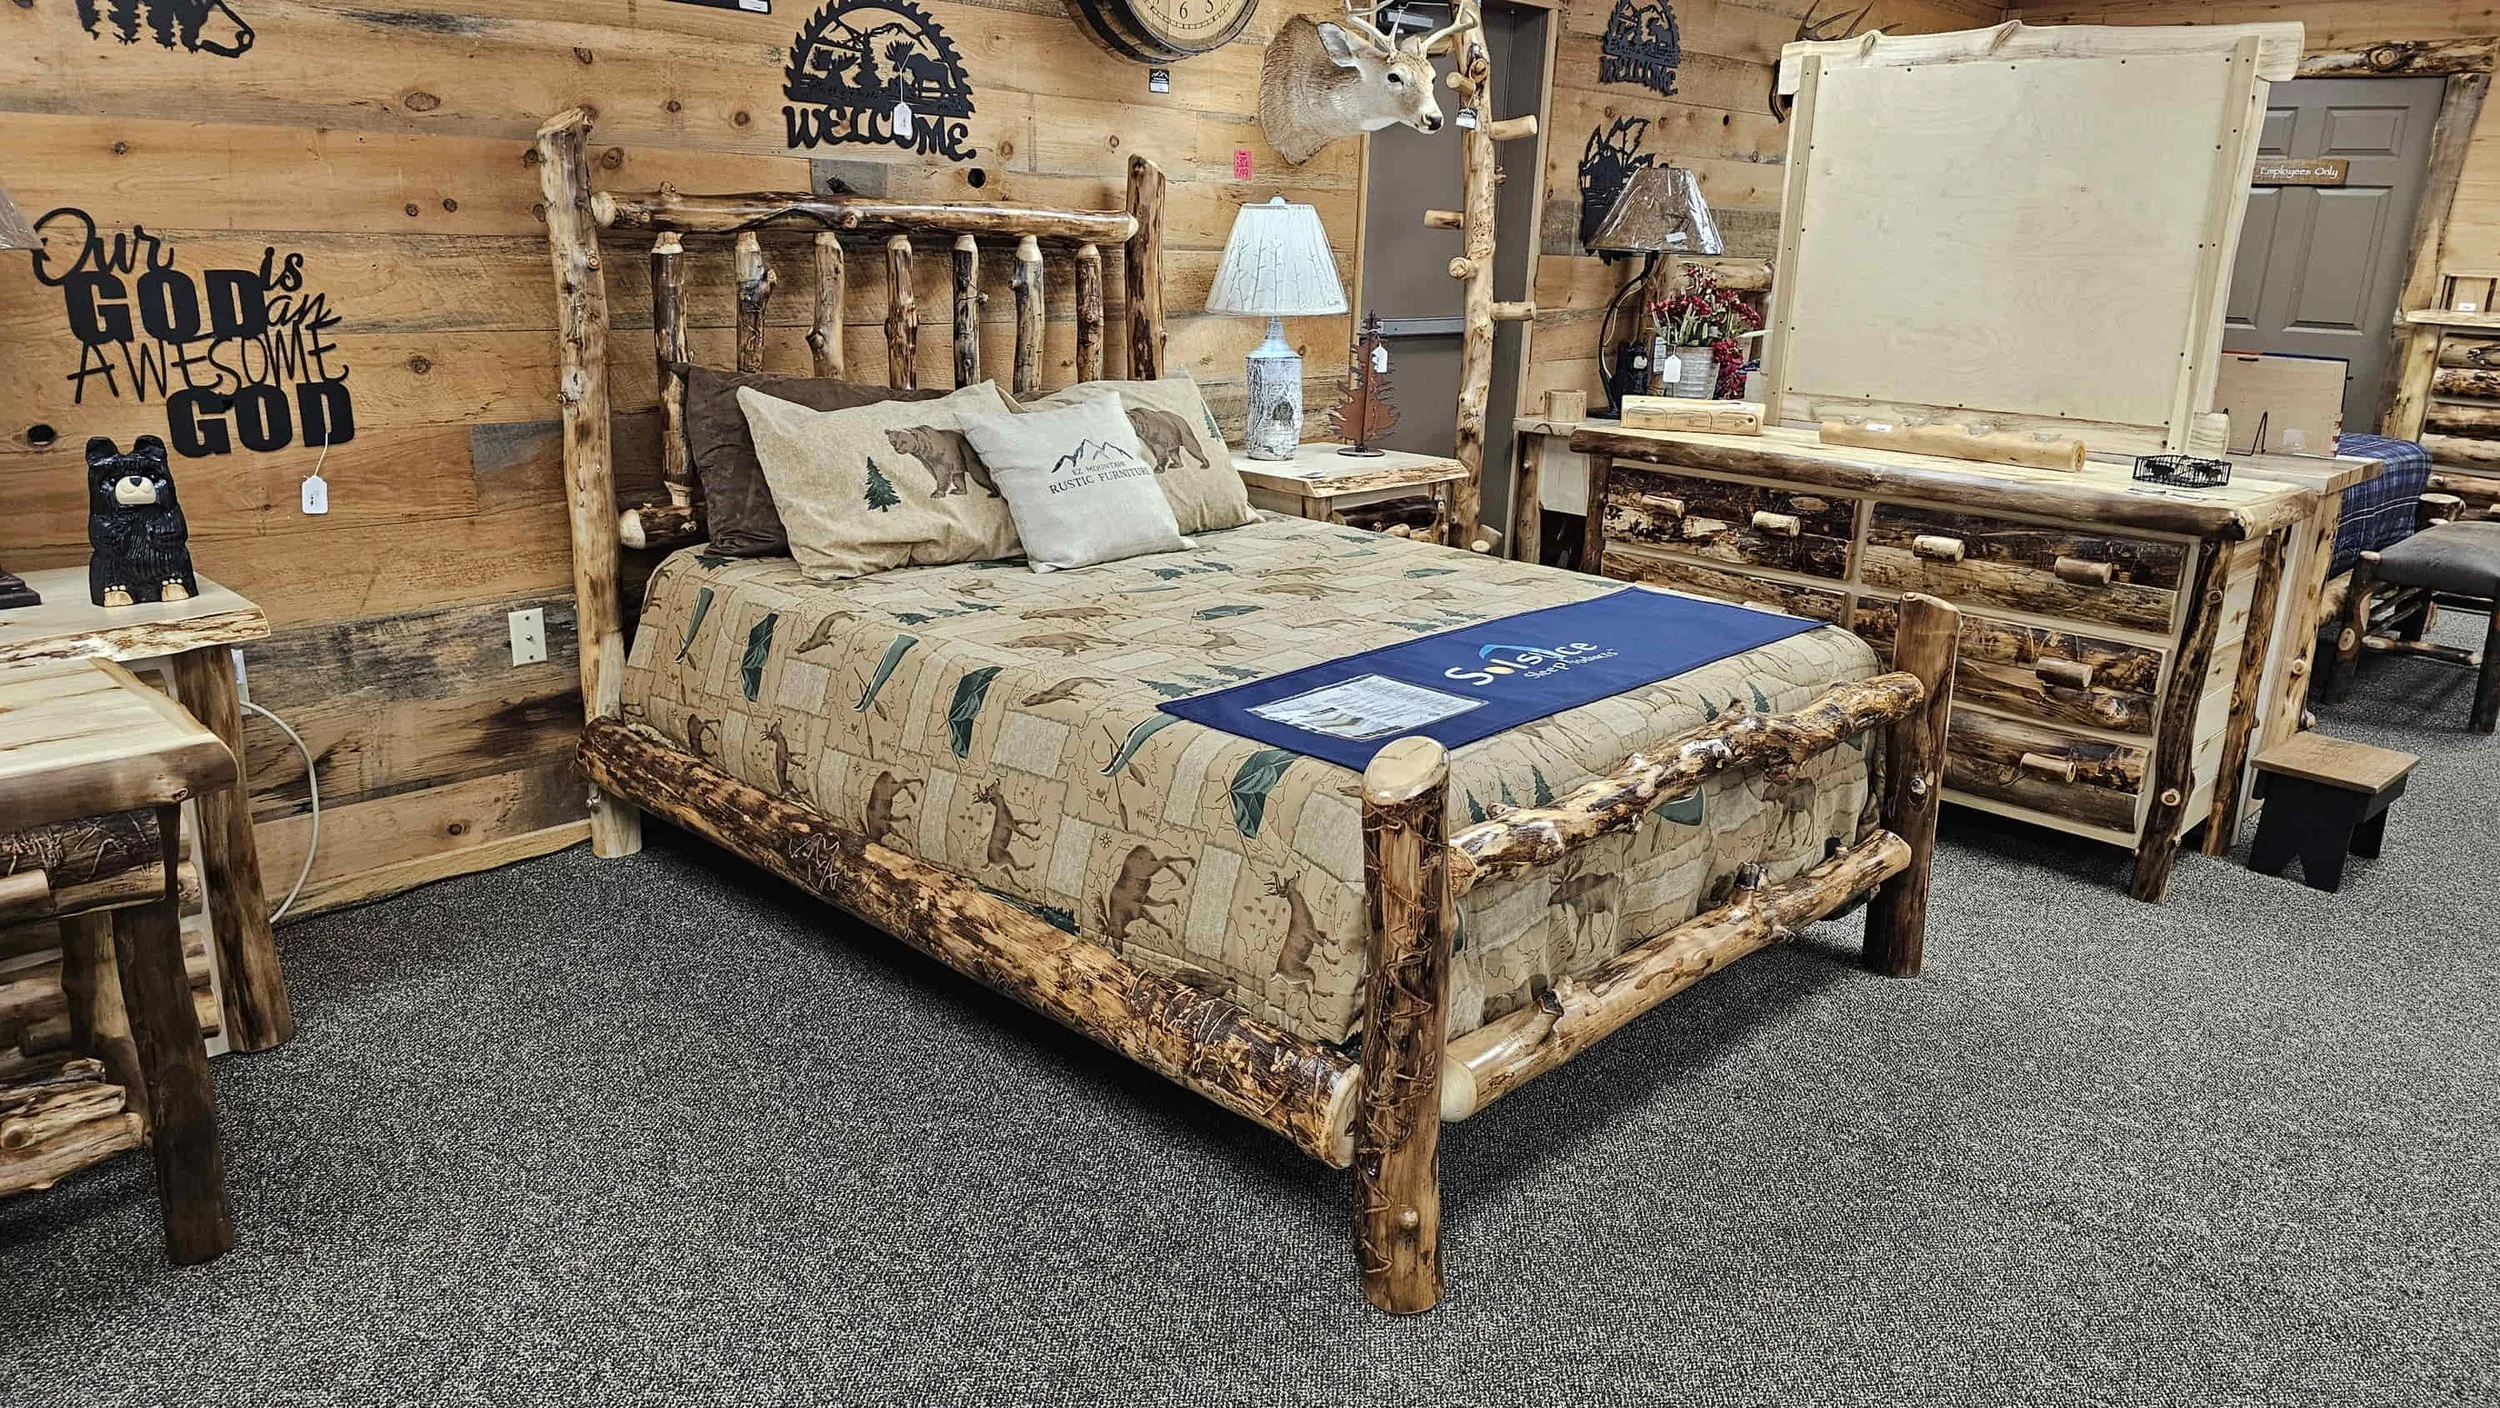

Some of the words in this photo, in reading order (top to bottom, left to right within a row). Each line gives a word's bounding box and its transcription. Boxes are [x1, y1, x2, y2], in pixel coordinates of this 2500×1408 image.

[1179, 1, 1188, 19] 6
[2260, 164, 2311, 178] Employees
[2314, 165, 2339, 180] Only
[31, 207, 175, 286] Our
[259, 246, 303, 291] is
[64, 269, 268, 344] GOD
[267, 292, 342, 330] an
[67, 322, 349, 404] AWESOME
[166, 381, 355, 458] GOD
[1049, 475, 1095, 494] RUSTIC
[1086, 460, 1126, 473] MOUNTAIN
[1523, 660, 1571, 680] Sleep
